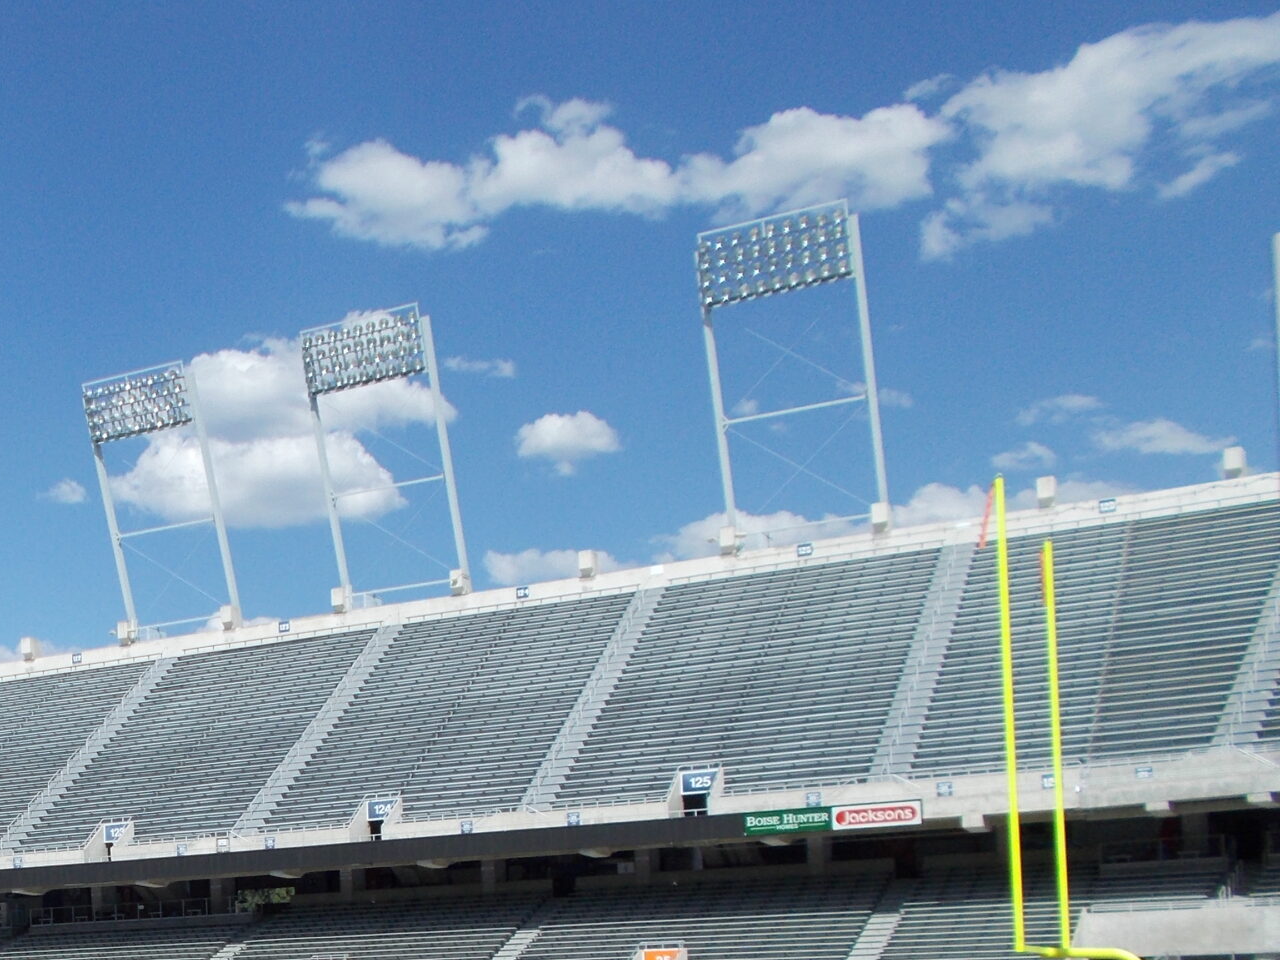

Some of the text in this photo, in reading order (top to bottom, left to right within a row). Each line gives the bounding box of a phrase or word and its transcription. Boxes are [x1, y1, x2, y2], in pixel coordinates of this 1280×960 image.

[690, 776, 711, 789] 125
[374, 804, 391, 815] 124
[840, 807, 913, 825] Jacksons
[746, 812, 829, 828] BOISE HUNTER
